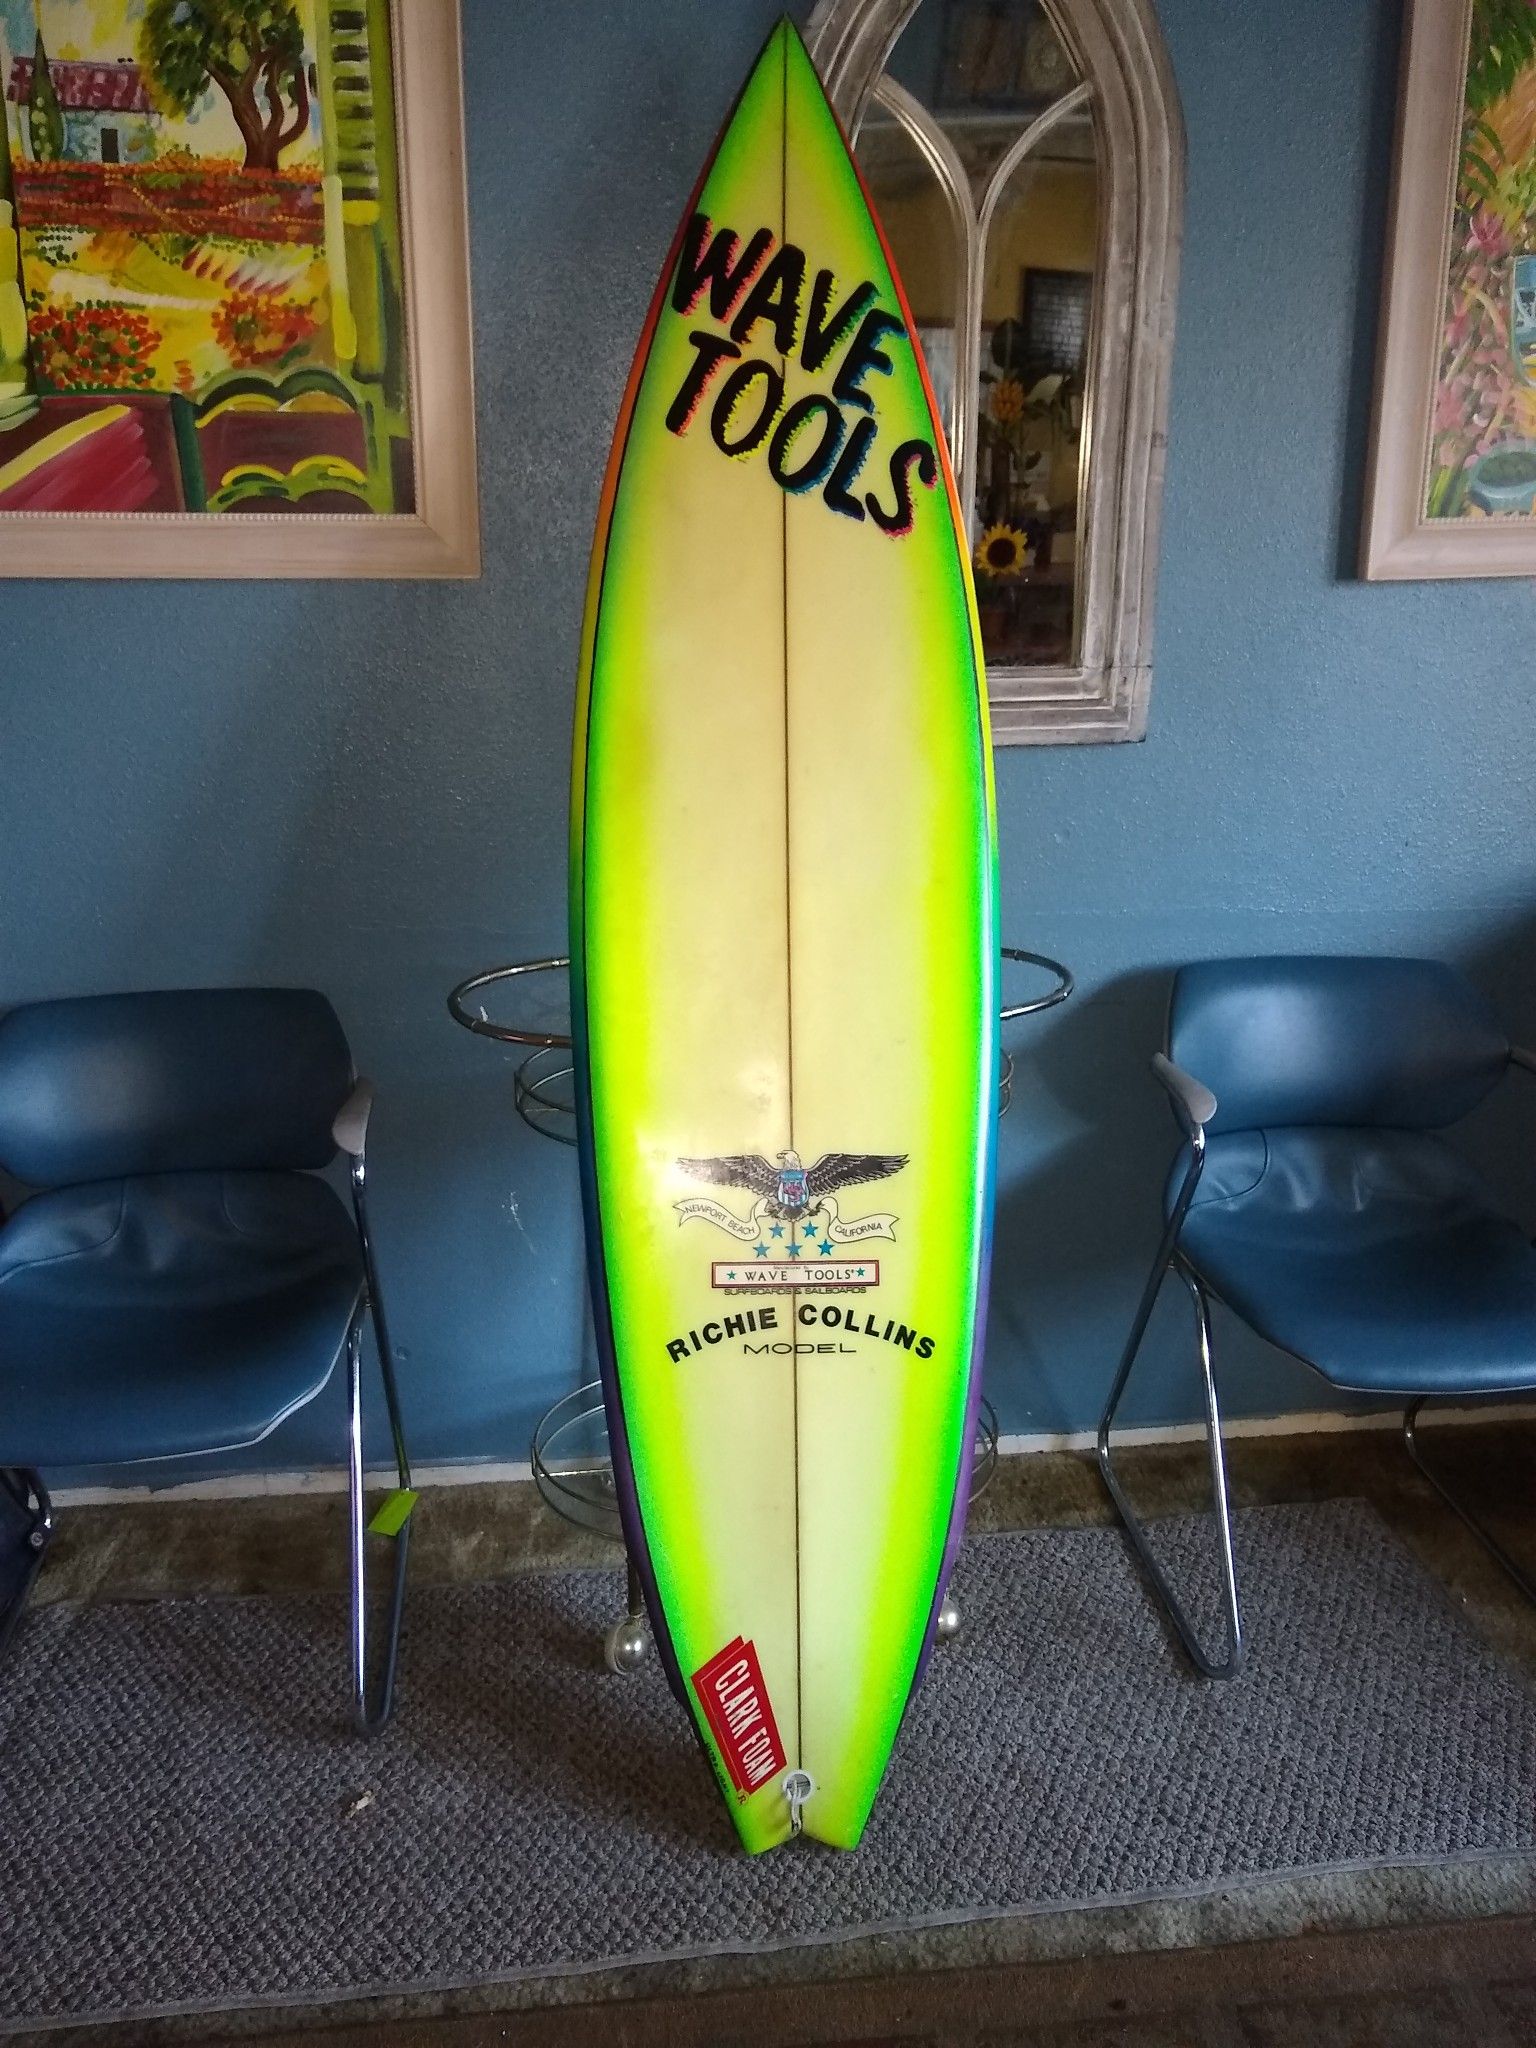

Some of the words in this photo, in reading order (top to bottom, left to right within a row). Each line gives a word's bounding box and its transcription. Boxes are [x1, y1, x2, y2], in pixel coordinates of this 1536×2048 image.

[672, 213, 909, 414] WAVE
[665, 330, 938, 539] TOOLS
[685, 1204, 727, 1222] NEWPORT
[727, 1219, 755, 1235] BEACH
[834, 1222, 883, 1237] CALIFORNIA
[724, 1288, 792, 1296] SURFBOARDS
[804, 1286, 866, 1295] SAILBOARDS
[744, 1270, 788, 1282] WAVE
[665, 1307, 778, 1363] RICHIE
[798, 1304, 936, 1359] COLLINS
[743, 1342, 857, 1354] MODEL
[715, 1659, 762, 1740] CLARK
[738, 1726, 776, 1786] FOAM
